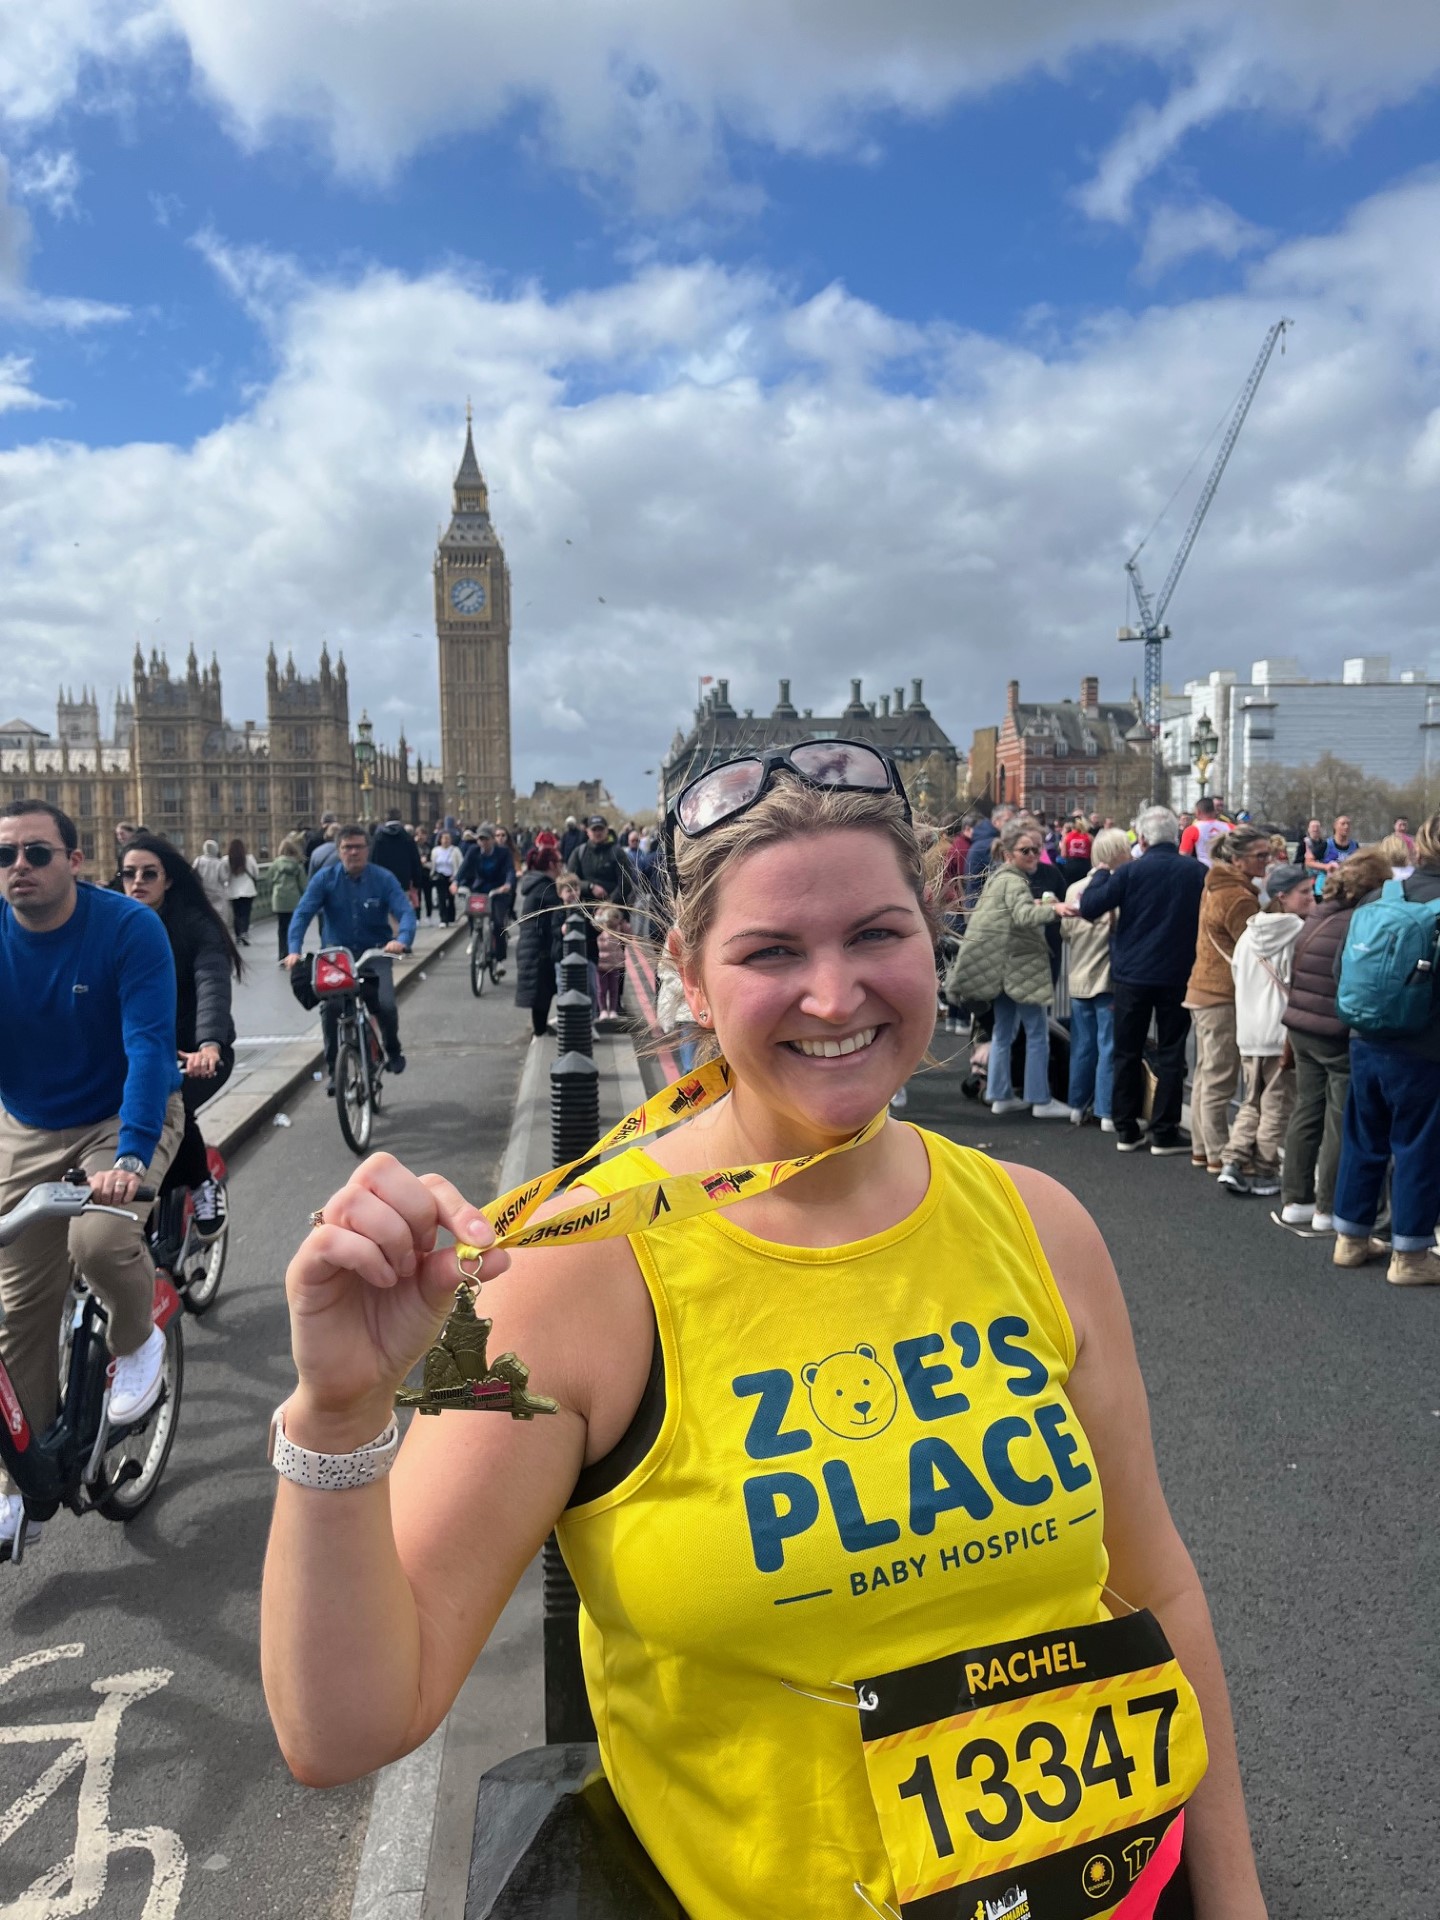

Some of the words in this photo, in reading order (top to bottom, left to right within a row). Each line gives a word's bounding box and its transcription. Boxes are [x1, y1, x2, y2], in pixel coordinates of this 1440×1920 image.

[494, 1180, 542, 1238] FINISHE
[517, 1202, 610, 1246] FINISHER
[742, 1402, 1092, 1573] PLACE
[850, 1554, 926, 1596] BABY
[940, 1518, 1059, 1572] HOSPICE
[964, 1640, 1087, 1695] RACHEL
[897, 1688, 1180, 1860] 13347
